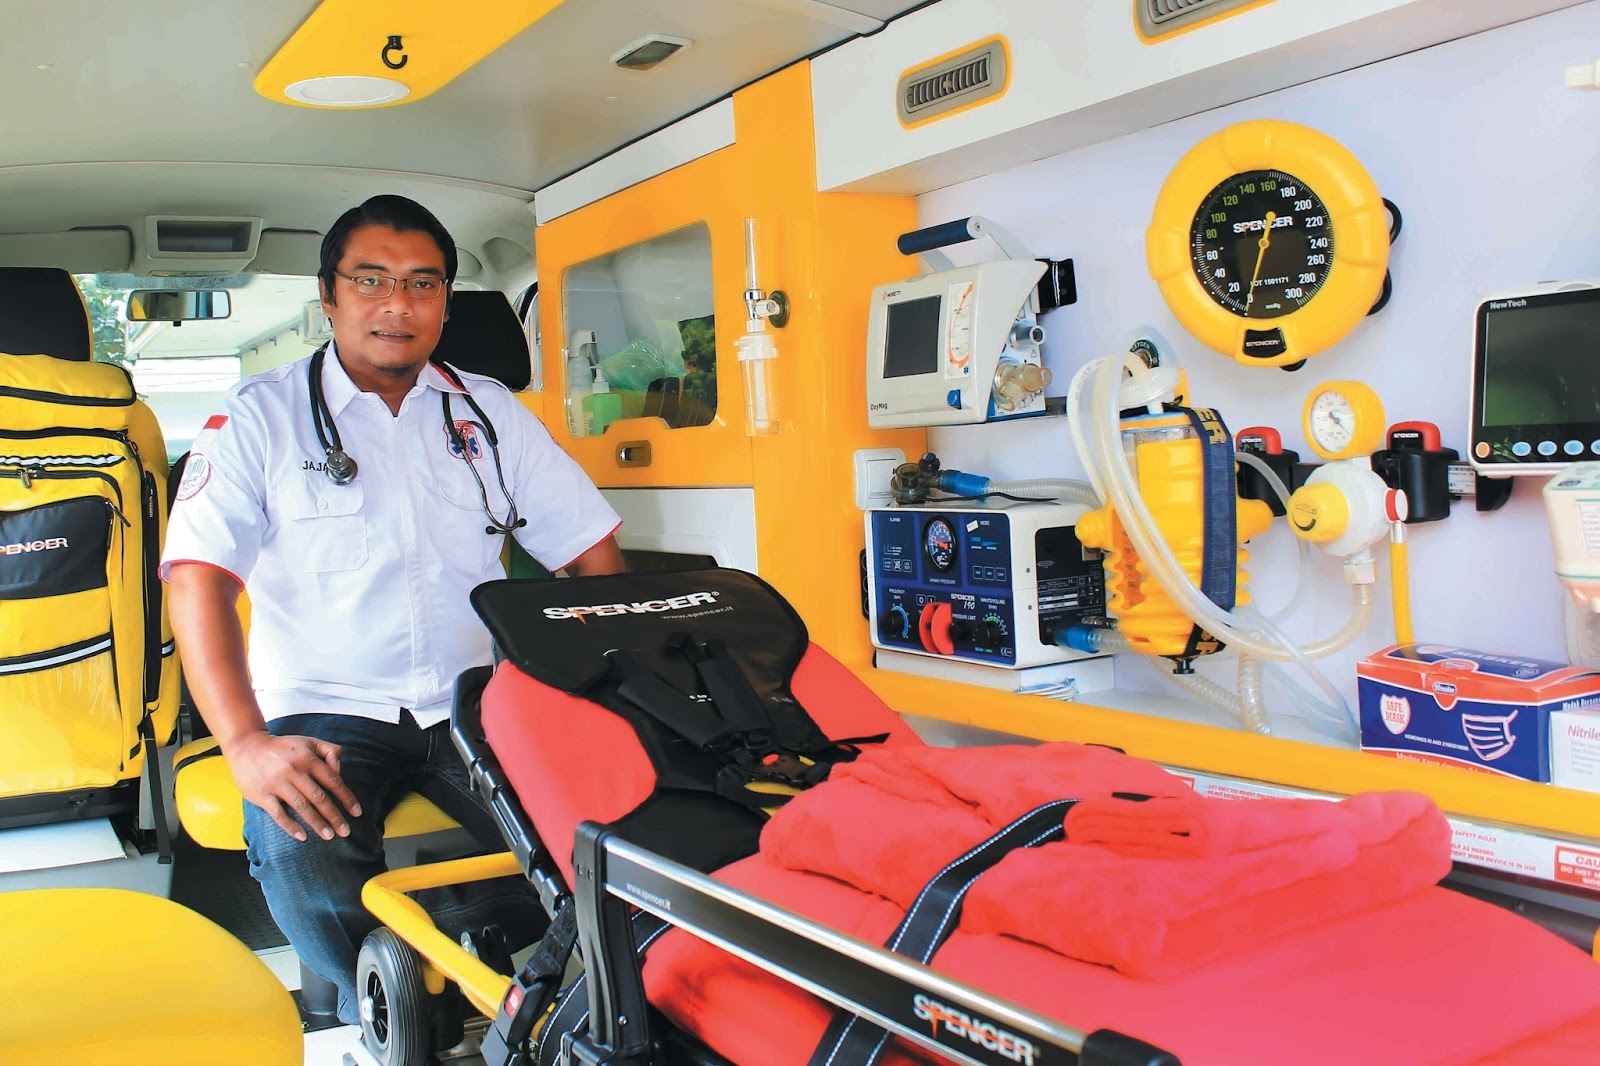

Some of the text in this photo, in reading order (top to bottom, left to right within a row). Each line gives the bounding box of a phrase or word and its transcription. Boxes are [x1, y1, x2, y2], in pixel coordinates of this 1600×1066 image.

[1240, 182, 1256, 194] 140
[1260, 180, 1276, 192] 160
[1280, 186, 1296, 198] 180
[1222, 194, 1238, 206] 120
[1294, 199, 1312, 212] 200
[1210, 212, 1226, 224] 100
[1305, 216, 1323, 228] 220
[1232, 216, 1294, 234] SPENCER
[1206, 228, 1217, 239] 80
[1310, 238, 1328, 250] 240
[1206, 250, 1218, 261] 60
[1307, 254, 1324, 266] 260
[1214, 268, 1226, 278] 40
[1298, 272, 1316, 284] 280
[1228, 282, 1240, 292] 20
[1284, 288, 1302, 298] 300
[1247, 293, 1254, 304] 0
[1490, 299, 1526, 310] NewTech
[1132, 341, 1150, 351] OXYGEN
[543, 592, 716, 624] SPENCER
[964, 601, 975, 610] 190
[662, 606, 734, 618] www.spencer.it
[1452, 650, 1538, 668] MASKER
[1386, 701, 1402, 712] SAFE
[1386, 712, 1404, 724] MASK
[1568, 725, 1600, 740] Nitrile
[1455, 830, 1476, 839] SAFETY
[1472, 848, 1494, 856] NEEDED
[1486, 857, 1507, 866] DEVICE
[1560, 864, 1573, 873] DO
[1575, 868, 1593, 877] NOT
[626, 882, 670, 910] www.spencer.it
[913, 994, 1034, 1066] SPENCER
